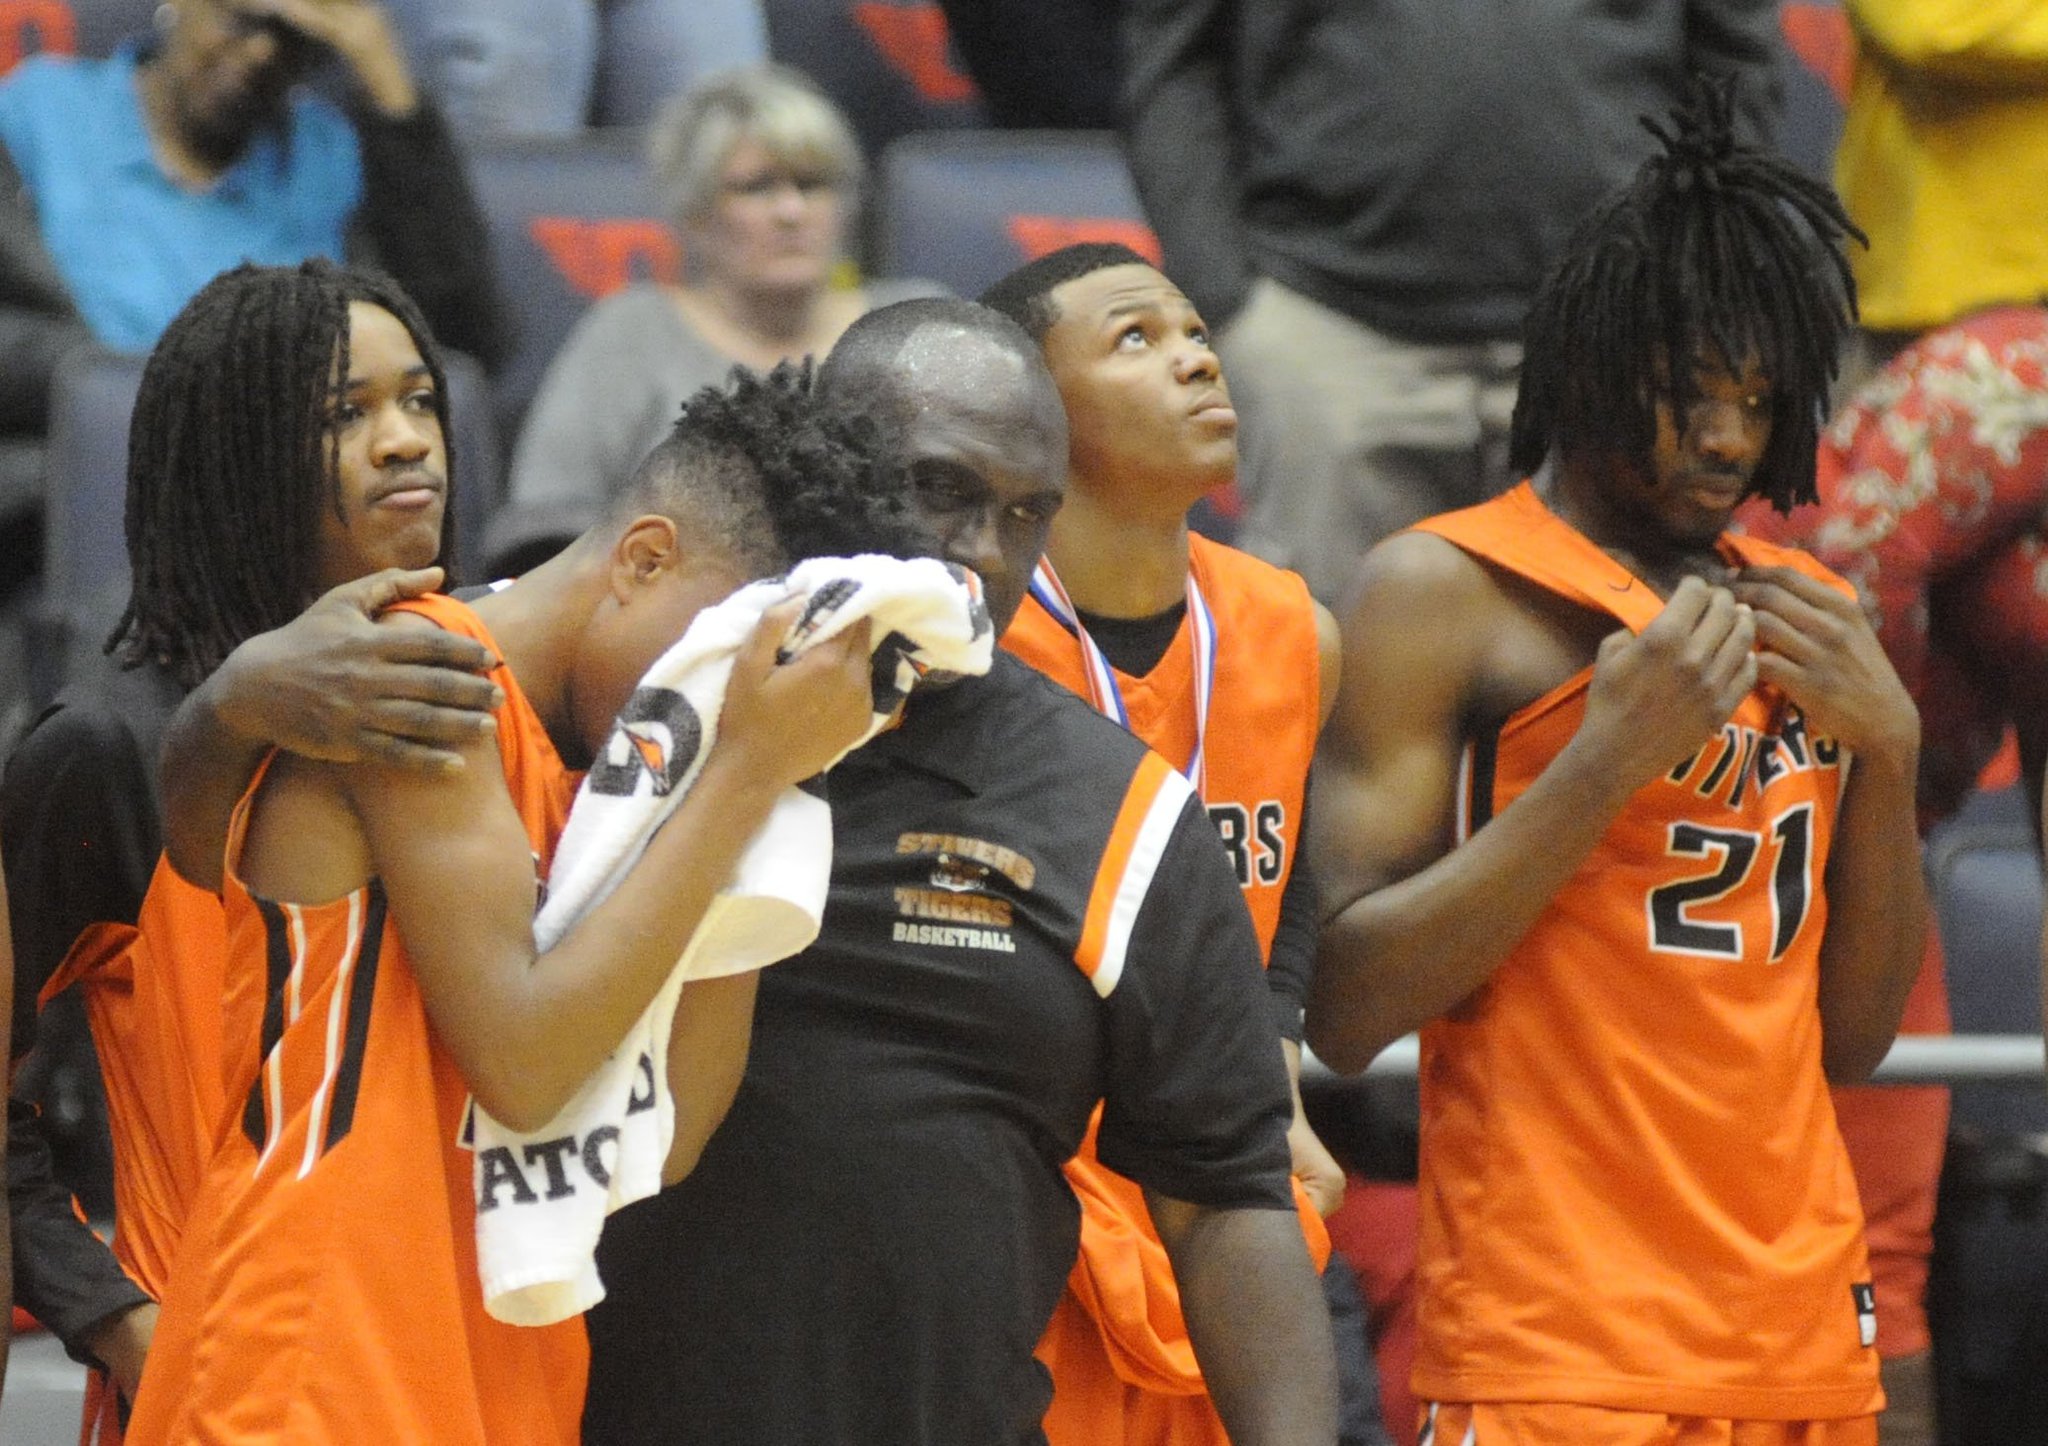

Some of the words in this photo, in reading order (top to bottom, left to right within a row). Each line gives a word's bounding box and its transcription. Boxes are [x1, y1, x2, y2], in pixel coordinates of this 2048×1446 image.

[895, 831, 1036, 891] STIVERS
[1646, 800, 1815, 965] 21
[893, 886, 1014, 929] TIGERS
[892, 921, 1016, 953] BASKETBALL
